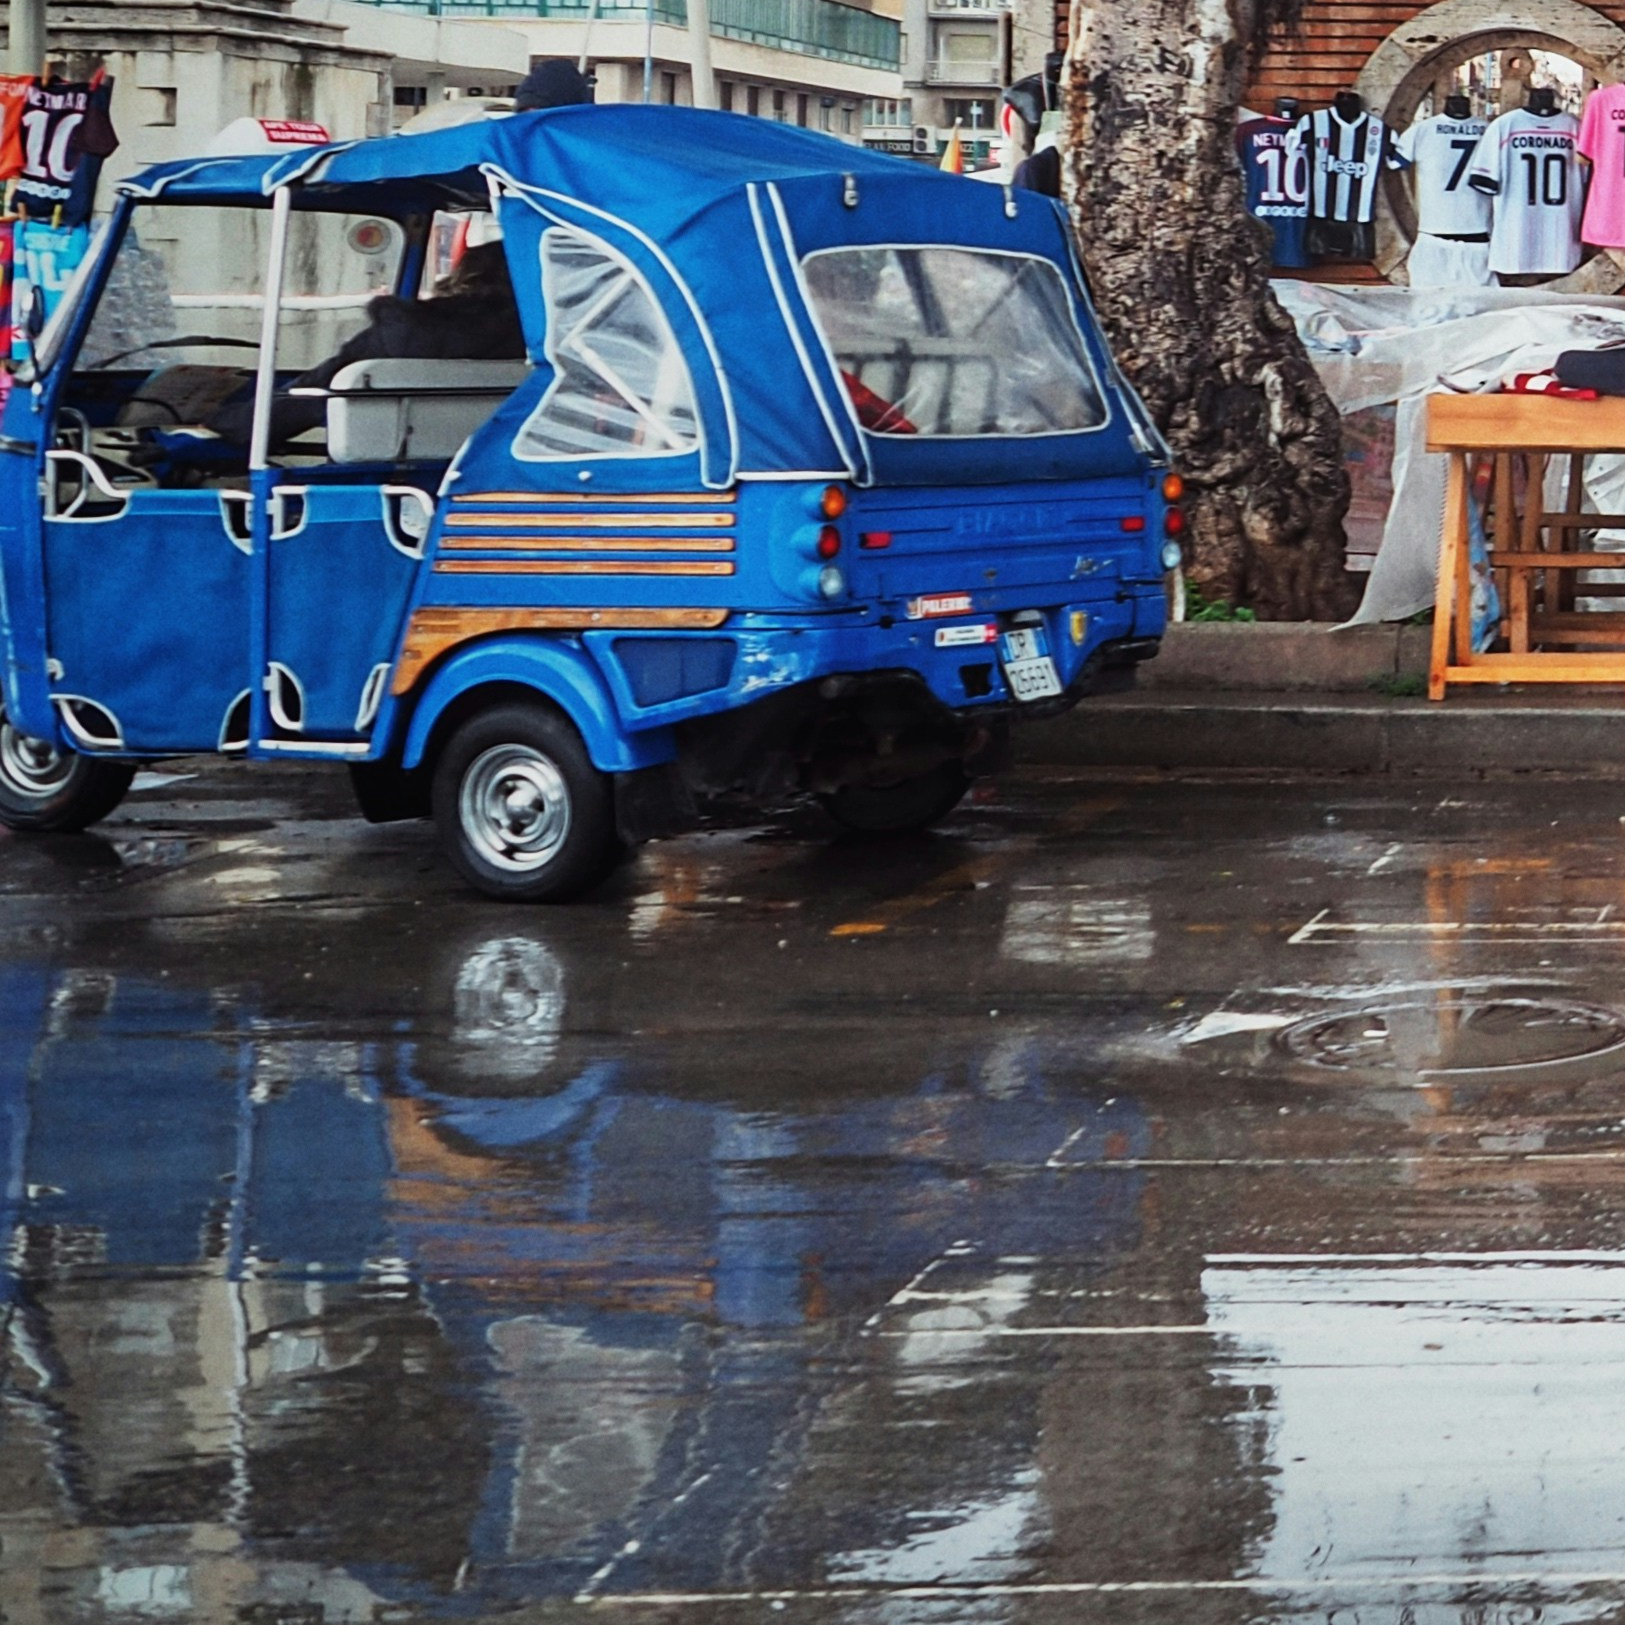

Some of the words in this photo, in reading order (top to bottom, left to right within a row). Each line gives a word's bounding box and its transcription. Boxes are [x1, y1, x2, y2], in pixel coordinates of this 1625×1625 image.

[1444, 139, 1478, 191] 7
[1512, 136, 1574, 150] CORONADO
[1256, 148, 1310, 202] 10
[1521, 153, 1567, 206] 10
